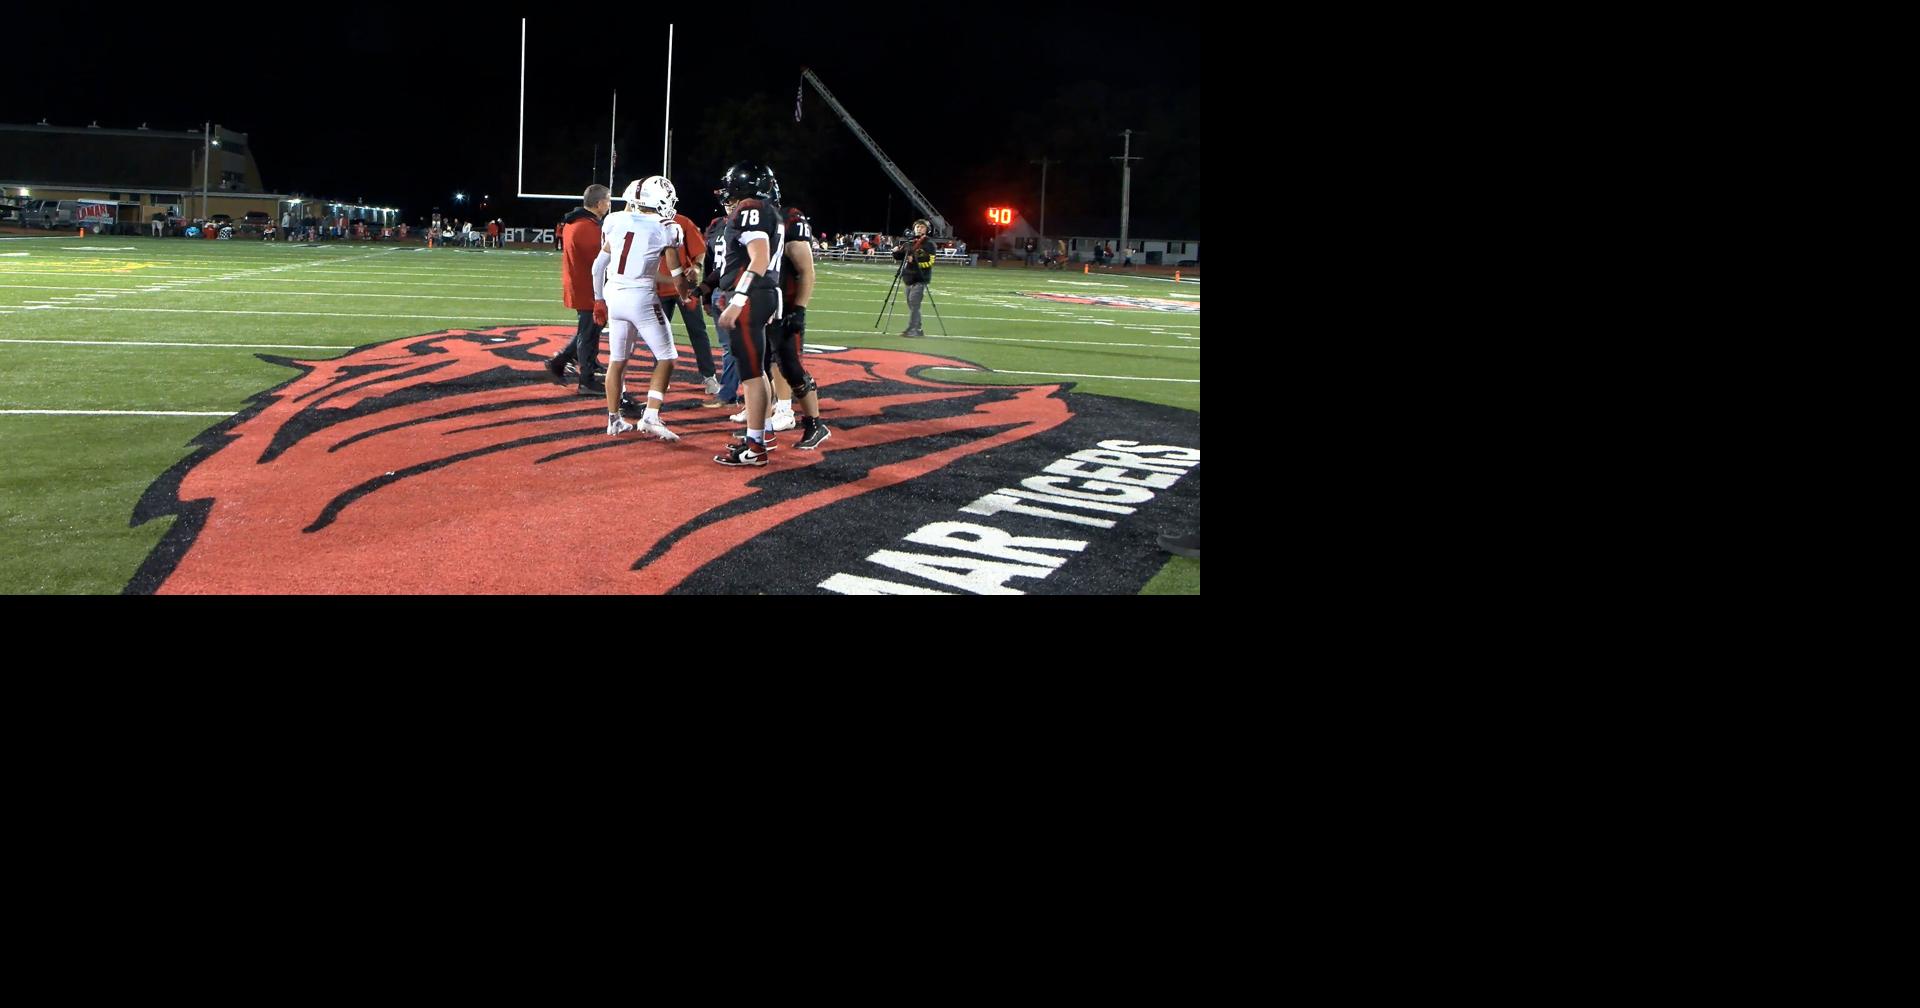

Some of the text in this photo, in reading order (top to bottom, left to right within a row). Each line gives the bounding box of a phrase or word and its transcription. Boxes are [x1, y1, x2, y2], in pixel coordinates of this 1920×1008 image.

[741, 209, 760, 227] 78
[989, 208, 1012, 224] 40
[504, 227, 555, 243] 87 76
[797, 222, 811, 238] 76
[617, 231, 635, 275] 1
[957, 439, 1200, 529] TIGERS
